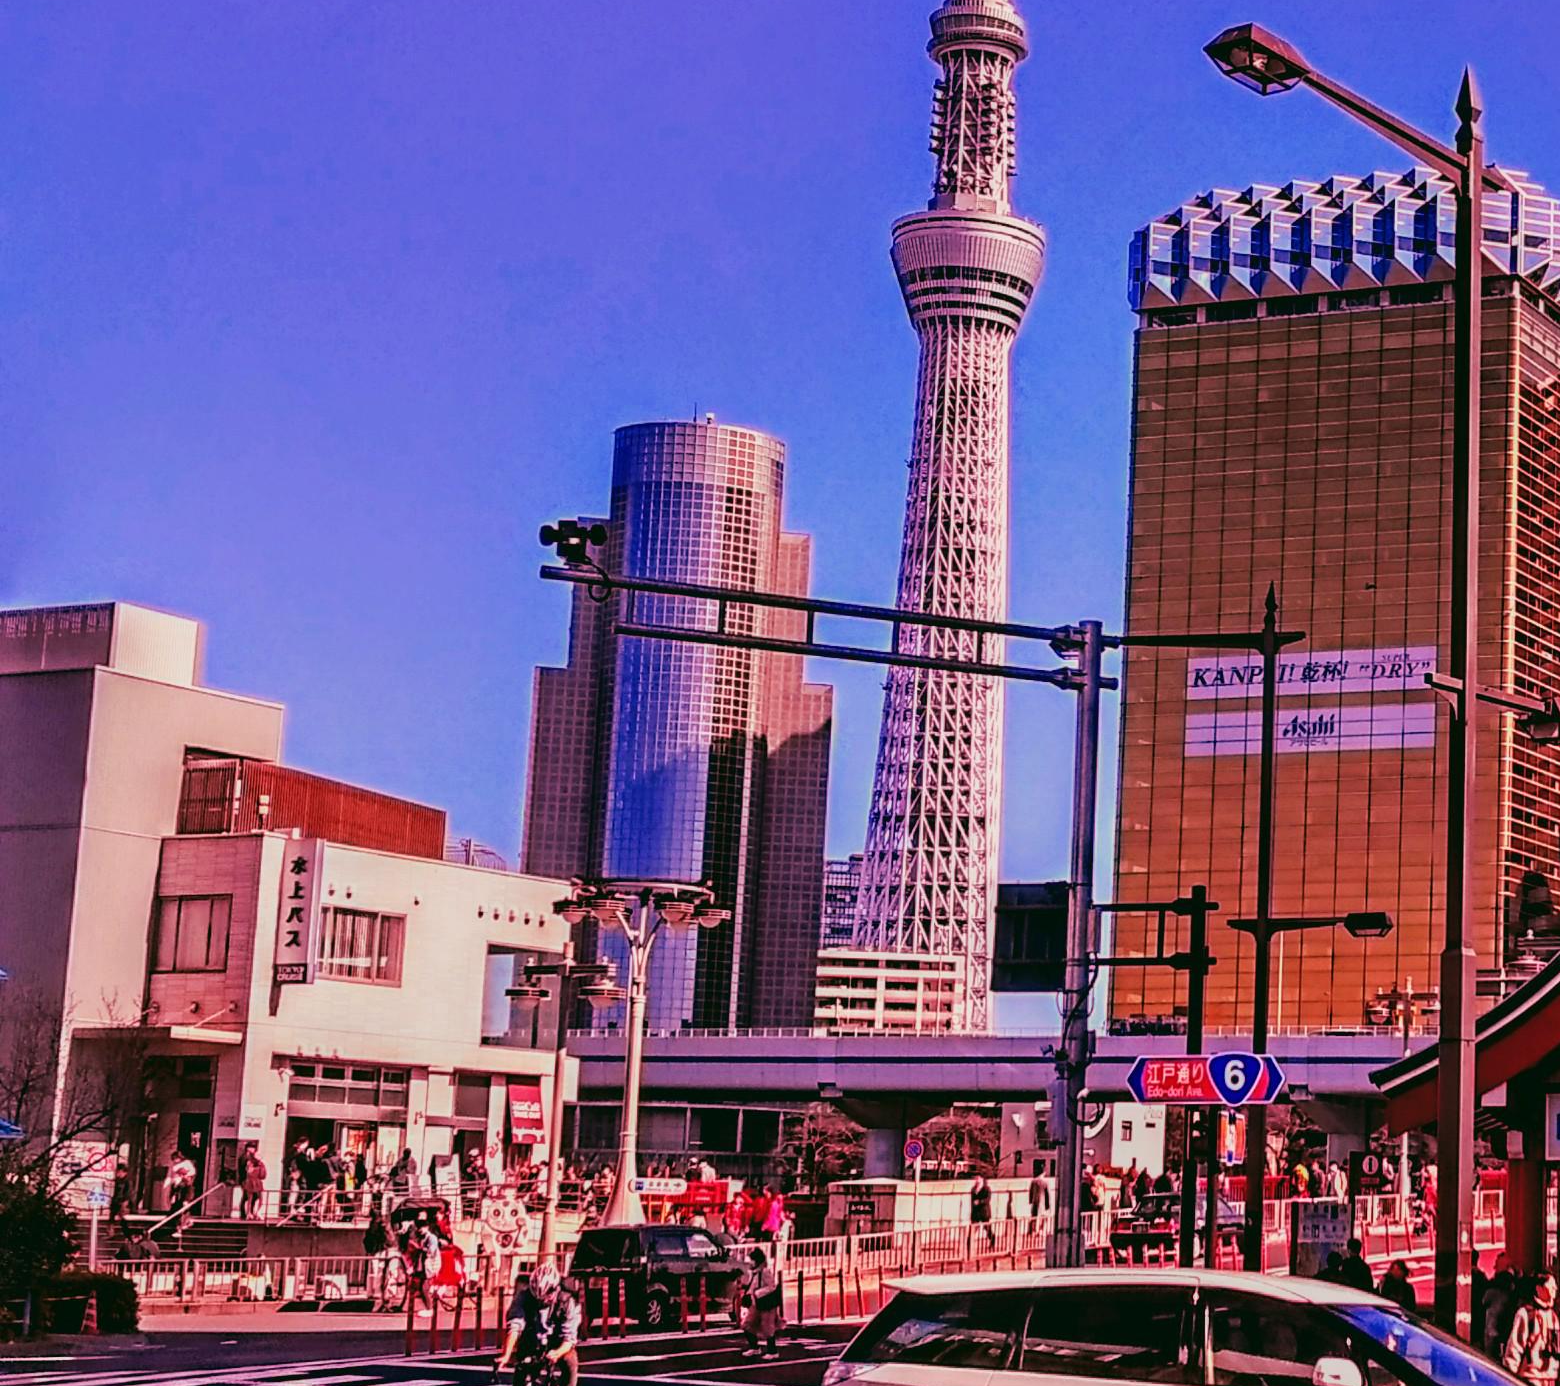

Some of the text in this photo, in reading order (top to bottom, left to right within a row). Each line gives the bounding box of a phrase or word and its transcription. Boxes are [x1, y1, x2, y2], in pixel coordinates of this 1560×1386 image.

[1193, 662, 1296, 688] KANPI!
[1282, 713, 1335, 737] Asahi
[1146, 1059, 1246, 1092] 江戸通り 6
[1147, 1085, 1184, 1098] Edo-dori
